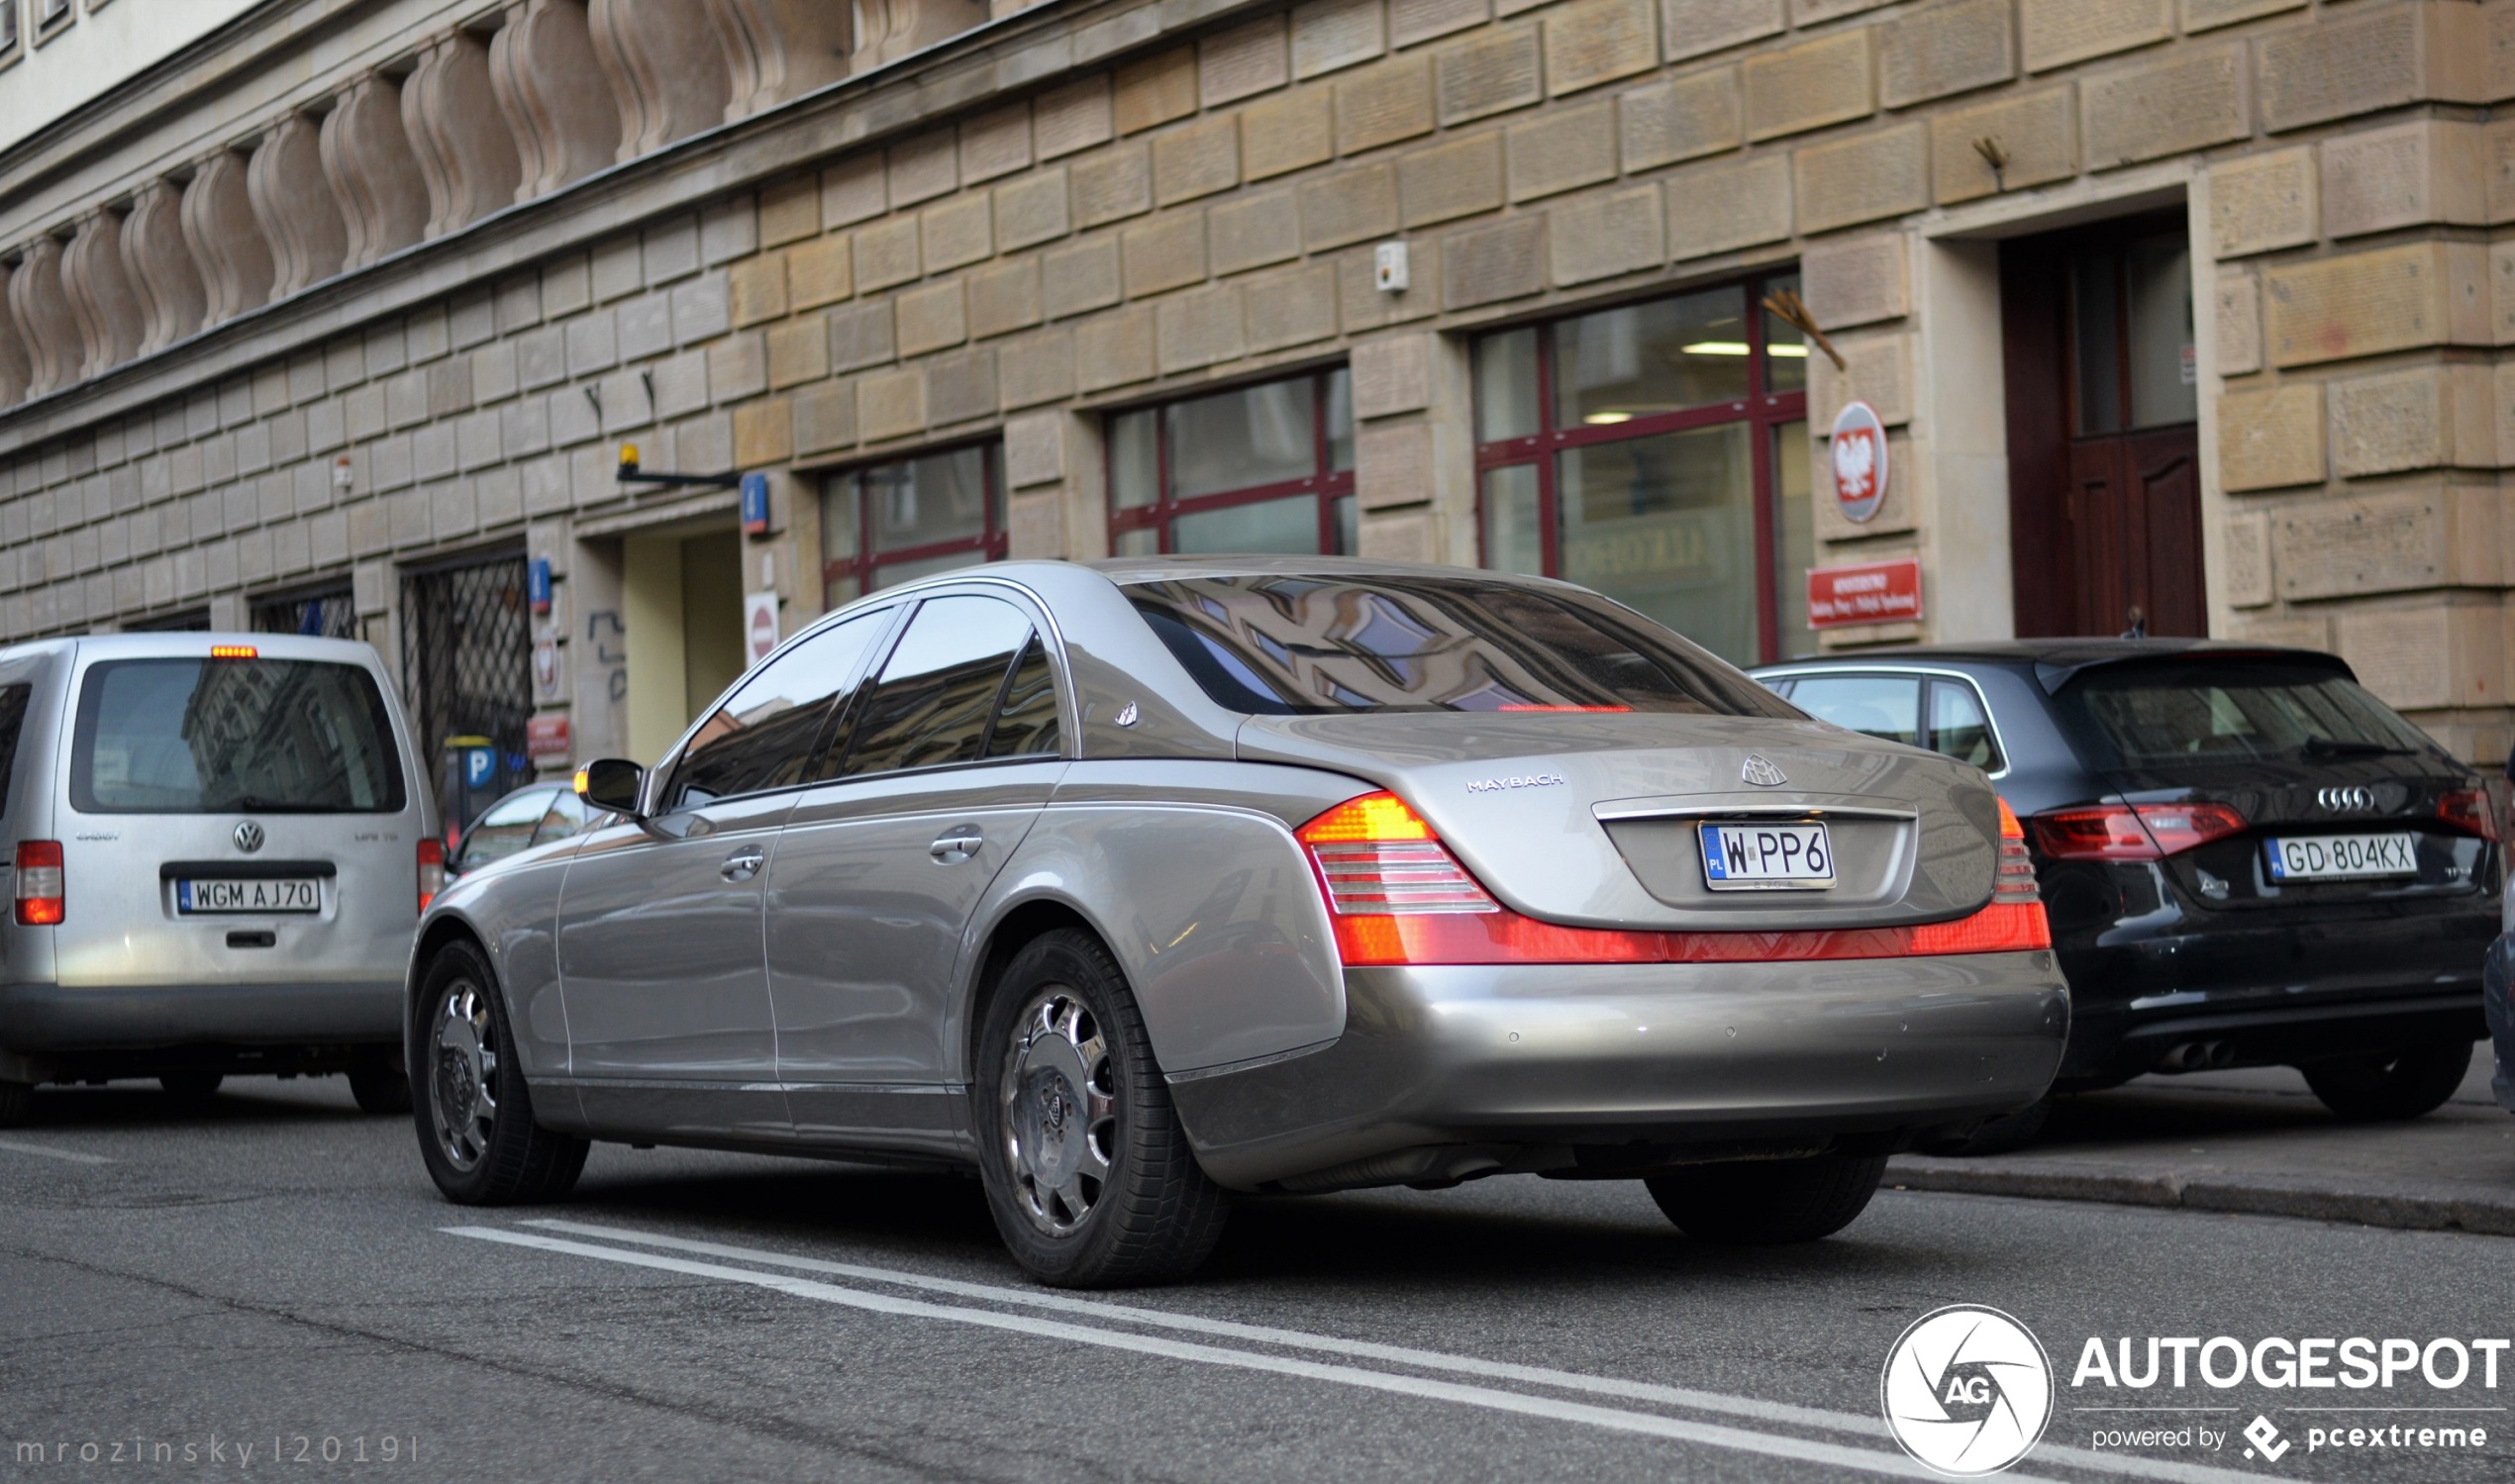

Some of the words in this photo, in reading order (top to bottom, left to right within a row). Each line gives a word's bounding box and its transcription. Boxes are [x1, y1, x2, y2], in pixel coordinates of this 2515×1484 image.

[469, 751, 488, 782] P
[1466, 774, 1563, 793] MAYBACH
[1709, 859, 1723, 870] PL
[1723, 833, 1748, 873] W
[1757, 833, 1825, 873] PP6
[2285, 841, 2325, 872] GD
[2333, 837, 2412, 870] 804KX
[197, 883, 244, 906] WGM
